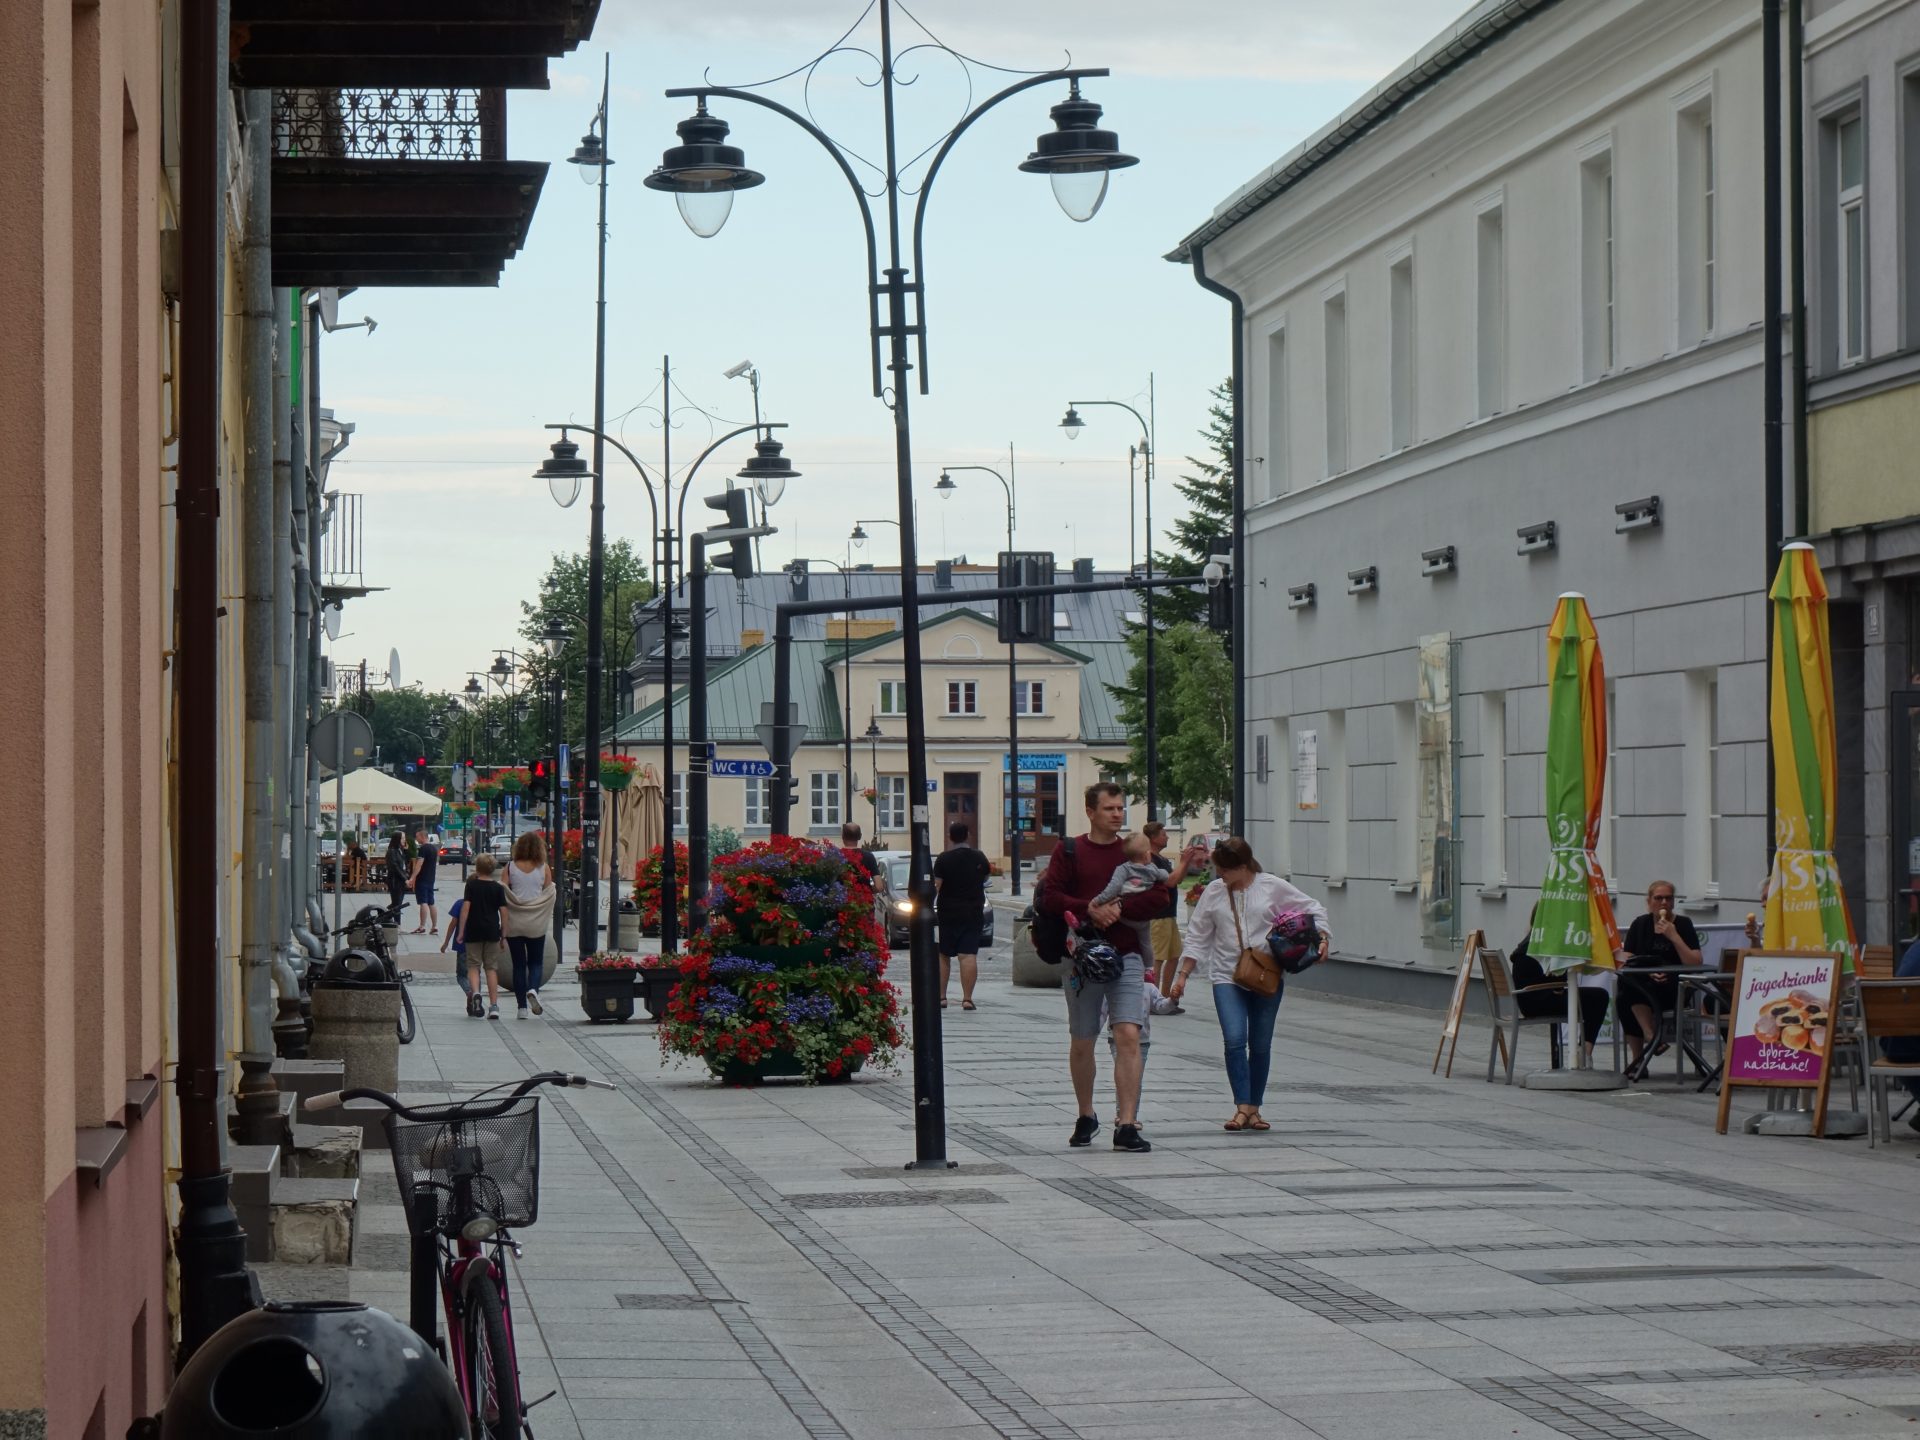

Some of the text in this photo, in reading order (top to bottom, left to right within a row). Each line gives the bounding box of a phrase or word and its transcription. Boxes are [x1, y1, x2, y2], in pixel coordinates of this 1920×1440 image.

[715, 762, 736, 773] WC
[1745, 966, 1829, 1000] jagodzianki
[1758, 1042, 1800, 1059] dobrze
[1743, 1056, 1810, 1073] nadziane!
